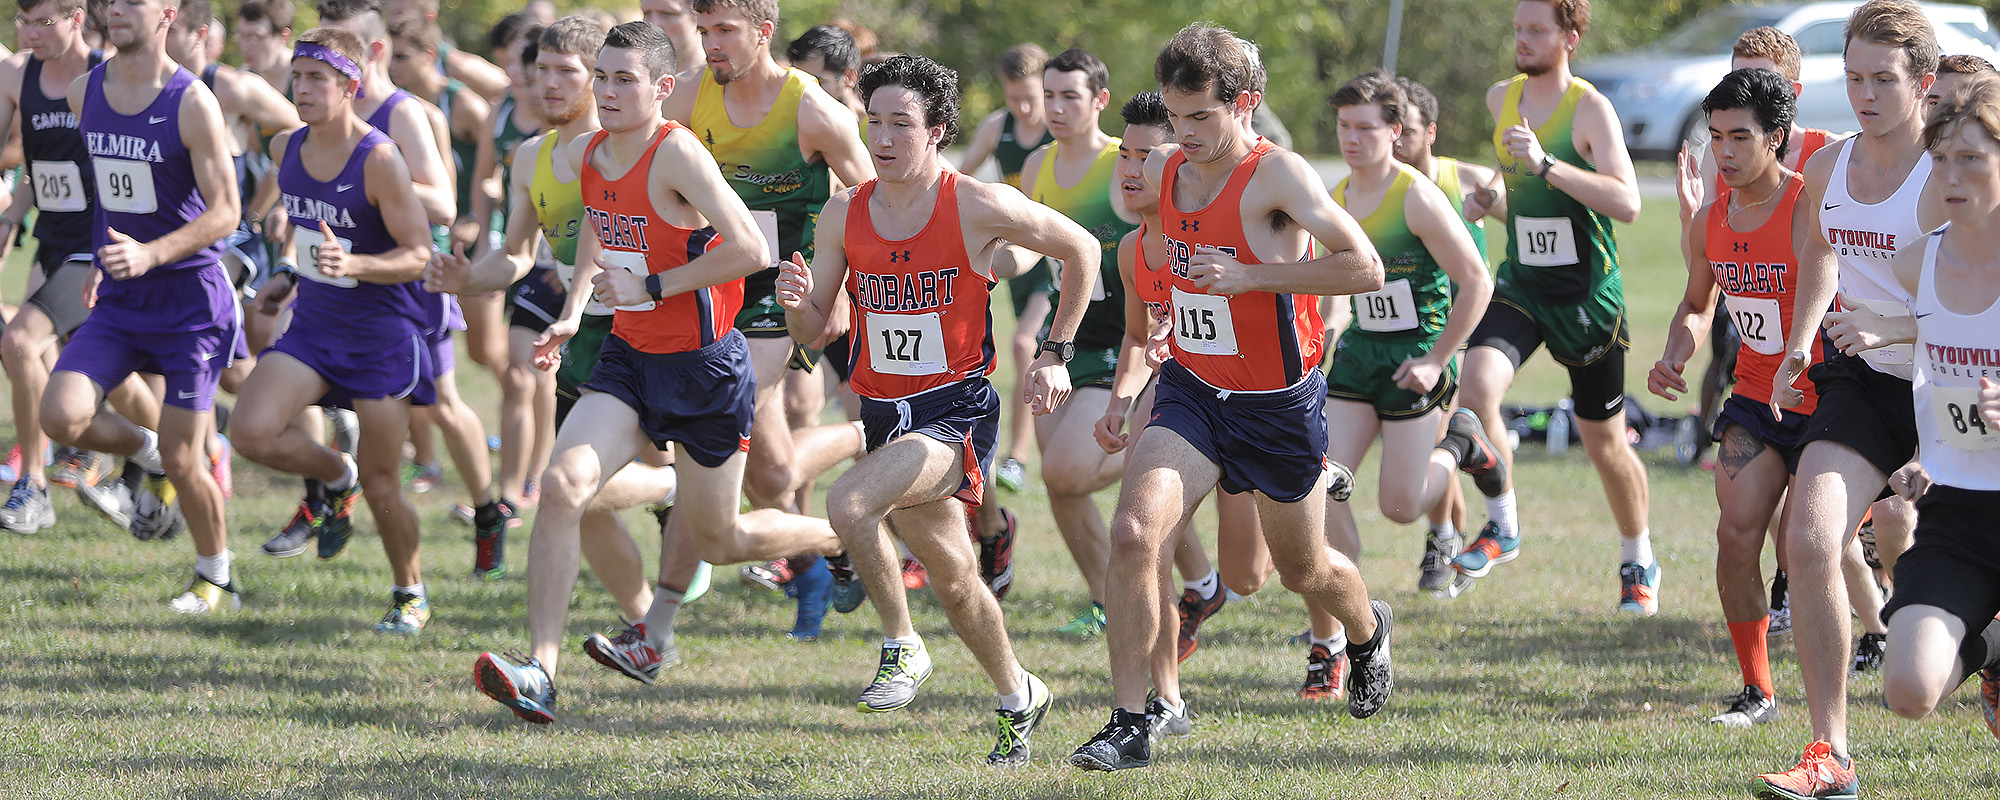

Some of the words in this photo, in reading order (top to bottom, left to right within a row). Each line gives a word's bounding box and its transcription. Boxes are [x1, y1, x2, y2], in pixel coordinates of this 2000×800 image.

[86, 131, 165, 163] ELMIRA
[39, 173, 71, 198] 205
[109, 172, 133, 198] 99
[282, 191, 357, 229] ELMIRA
[1527, 231, 1557, 254] 197
[1828, 227, 1896, 252] D'YOUVILLE
[855, 266, 959, 312] HOBART
[1366, 295, 1399, 319] 191
[1179, 305, 1217, 341] 115
[1735, 310, 1766, 341] 122
[881, 329, 922, 361] 127
[1946, 402, 1988, 437] 84
